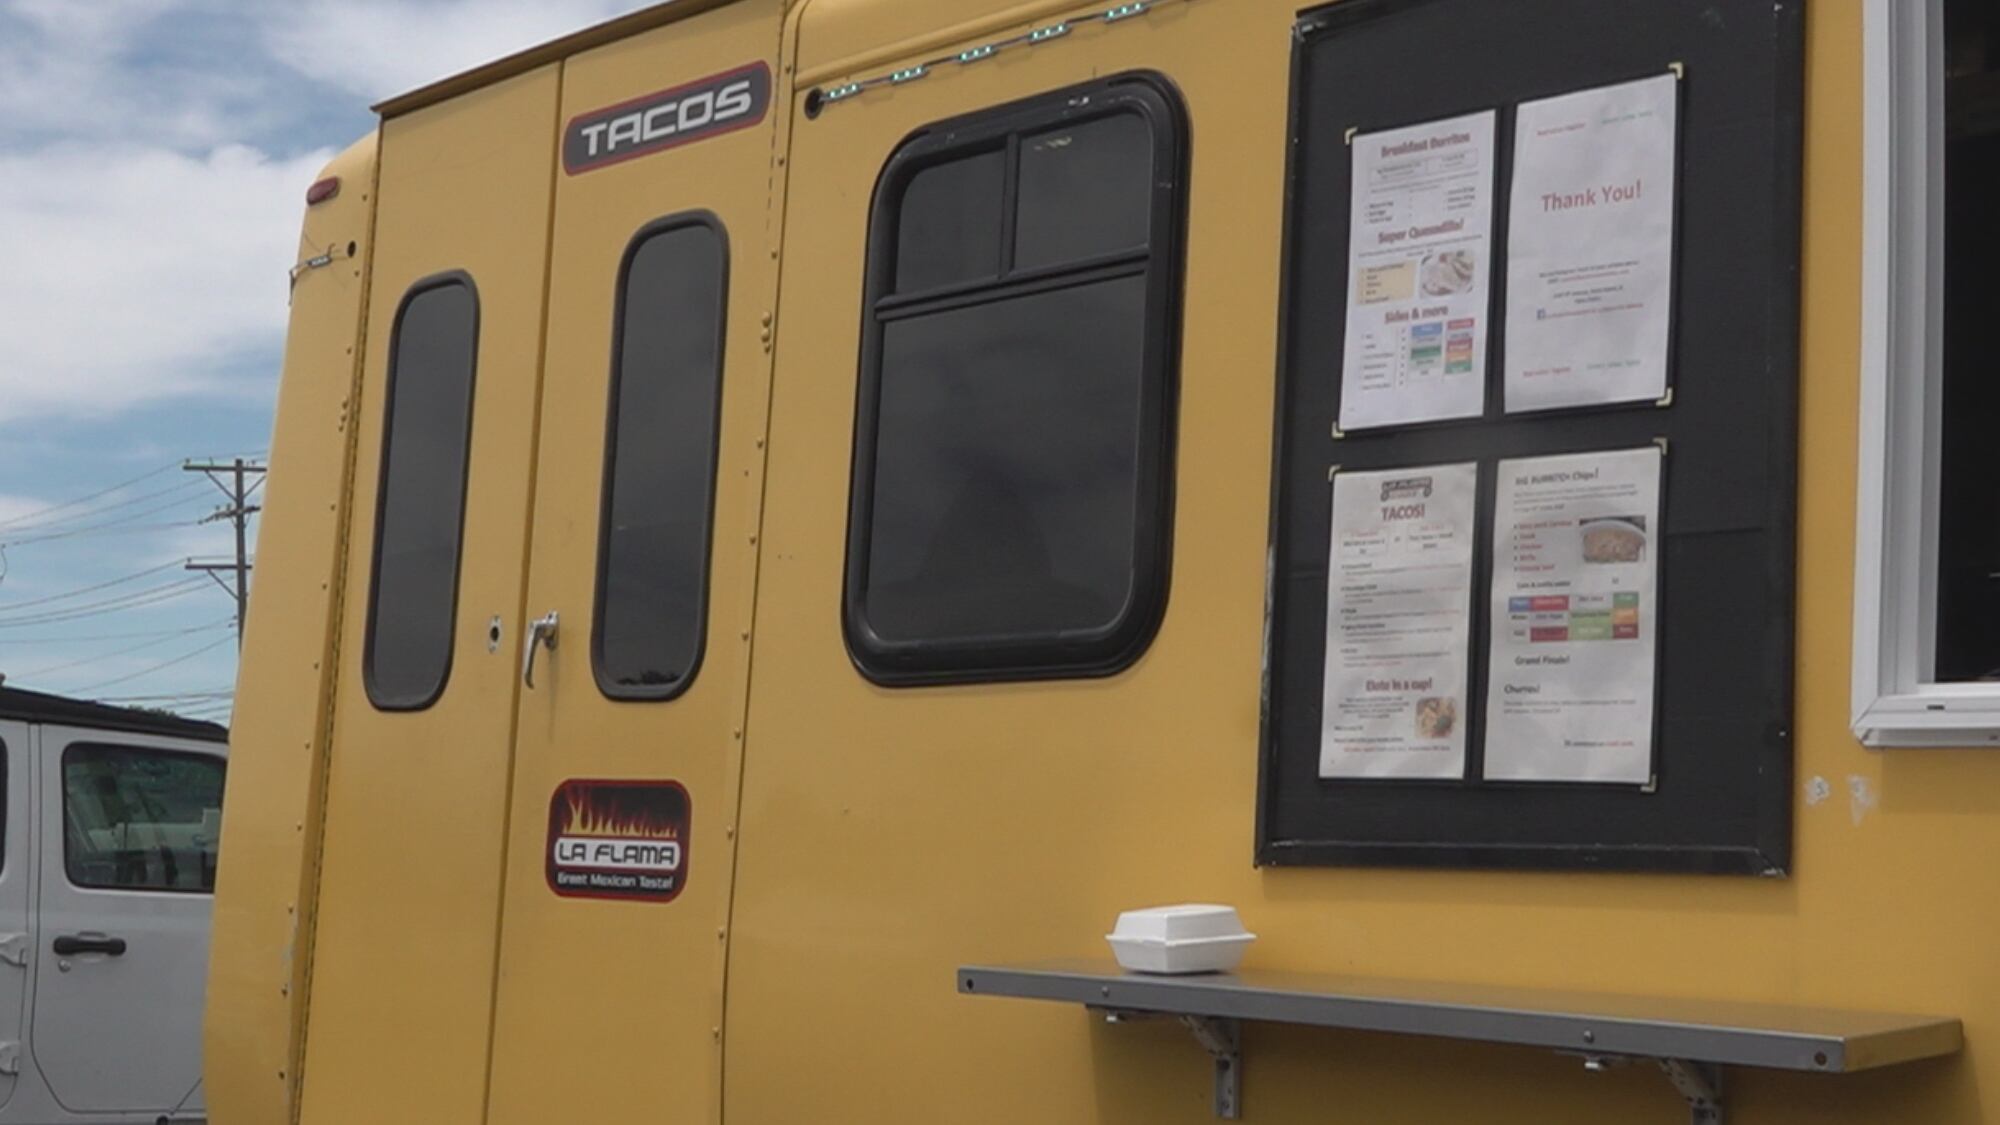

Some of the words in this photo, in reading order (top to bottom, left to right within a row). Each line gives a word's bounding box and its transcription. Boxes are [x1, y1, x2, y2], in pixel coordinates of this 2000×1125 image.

[581, 80, 752, 157] TACOS
[1381, 138, 1428, 158] Breakfast
[1429, 132, 1471, 150] Burritos
[1541, 188, 1597, 212] Thank
[1601, 178, 1642, 204] You!
[1378, 228, 1407, 244] Super
[1384, 309, 1409, 324] Sides
[1411, 307, 1420, 320] &
[1422, 306, 1448, 319] more
[1381, 503, 1426, 521] TACOS!
[1515, 656, 1541, 666] Grand
[1366, 679, 1390, 692] Elote
[1392, 678, 1402, 691] in
[1411, 676, 1433, 692] cup!
[1504, 684, 1541, 694] Churros!
[558, 842, 587, 862] LA
[594, 844, 675, 866] FLAMA
[557, 872, 588, 886] Great
[590, 873, 636, 888] Mexican
[639, 875, 674, 889] Taste!
